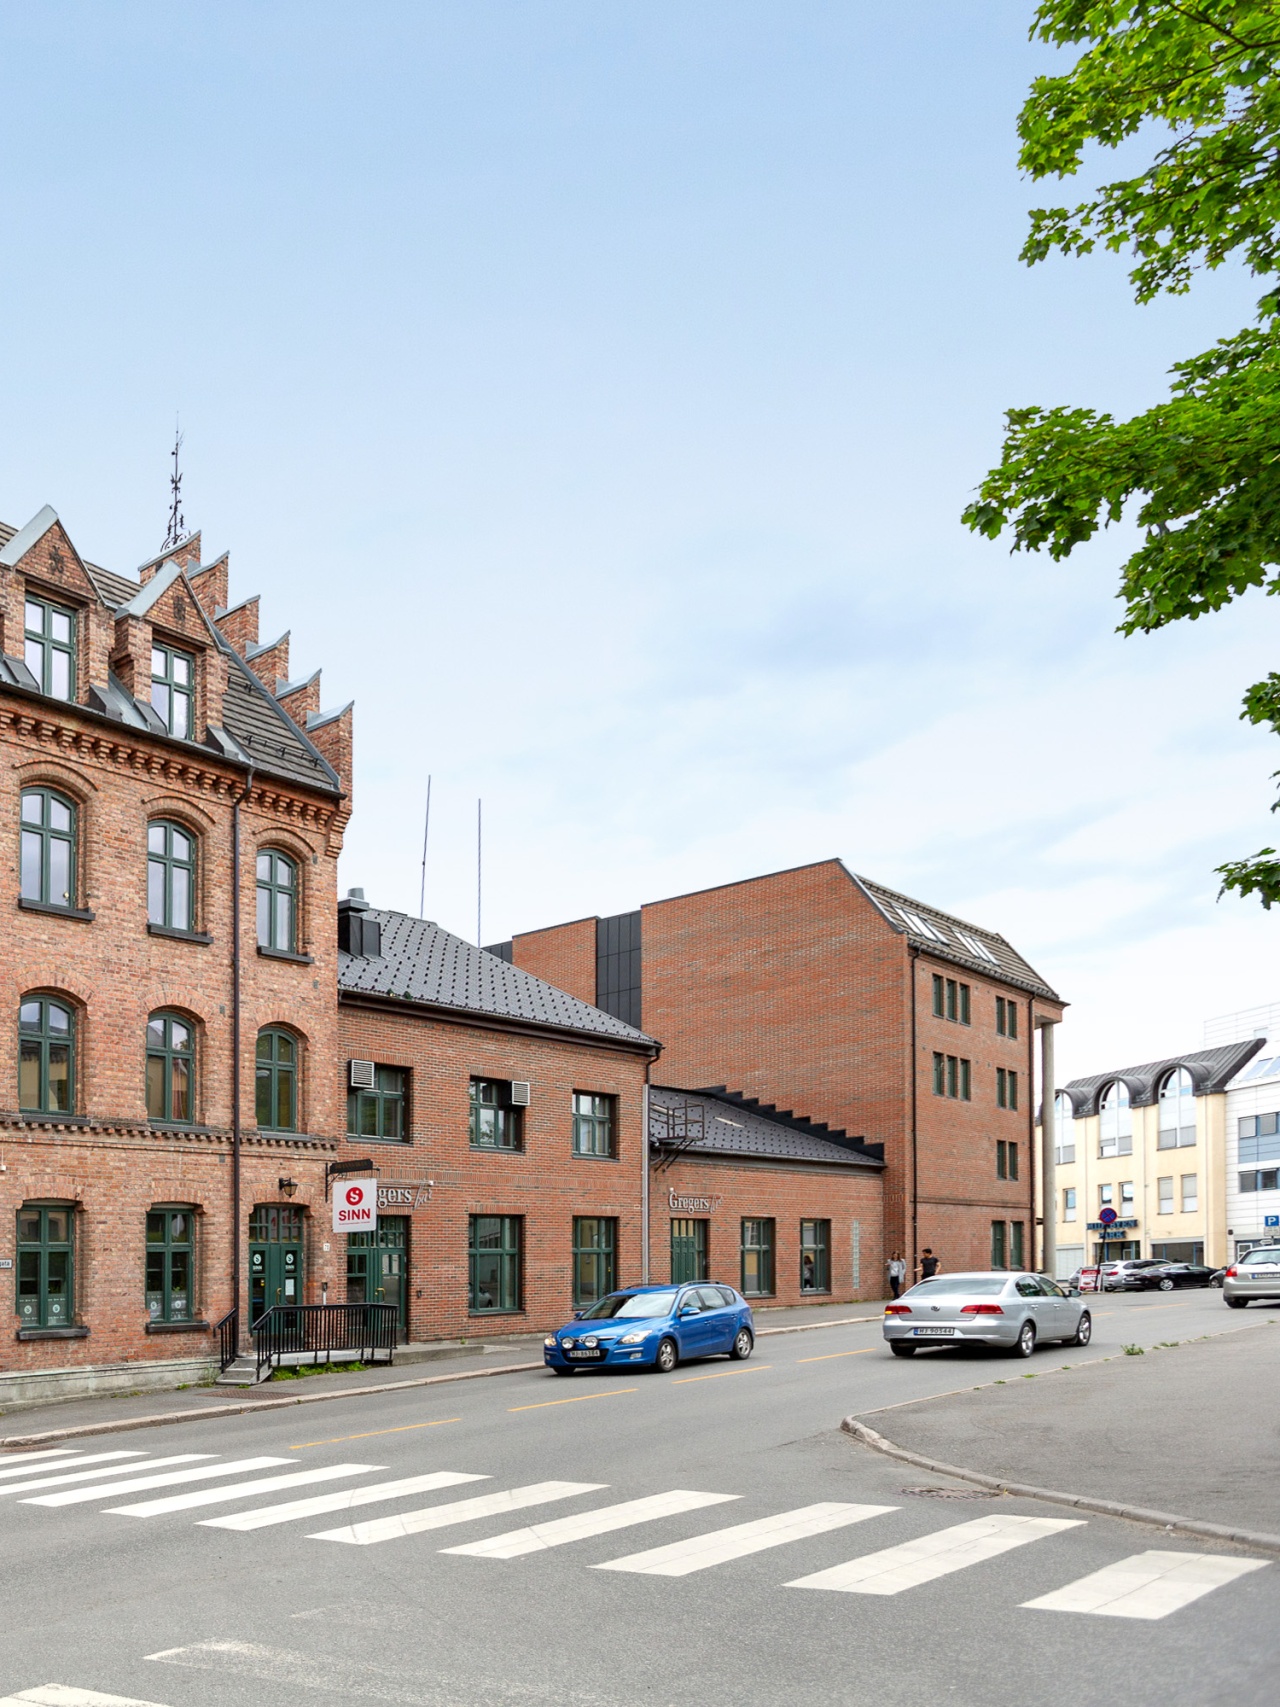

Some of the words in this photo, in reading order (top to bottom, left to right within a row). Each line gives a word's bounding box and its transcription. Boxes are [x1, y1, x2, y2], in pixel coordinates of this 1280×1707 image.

[376, 1188, 412, 1208] gers
[669, 1192, 709, 1214] Gregers
[338, 1208, 371, 1221] SINN
[1267, 1216, 1277, 1226] P
